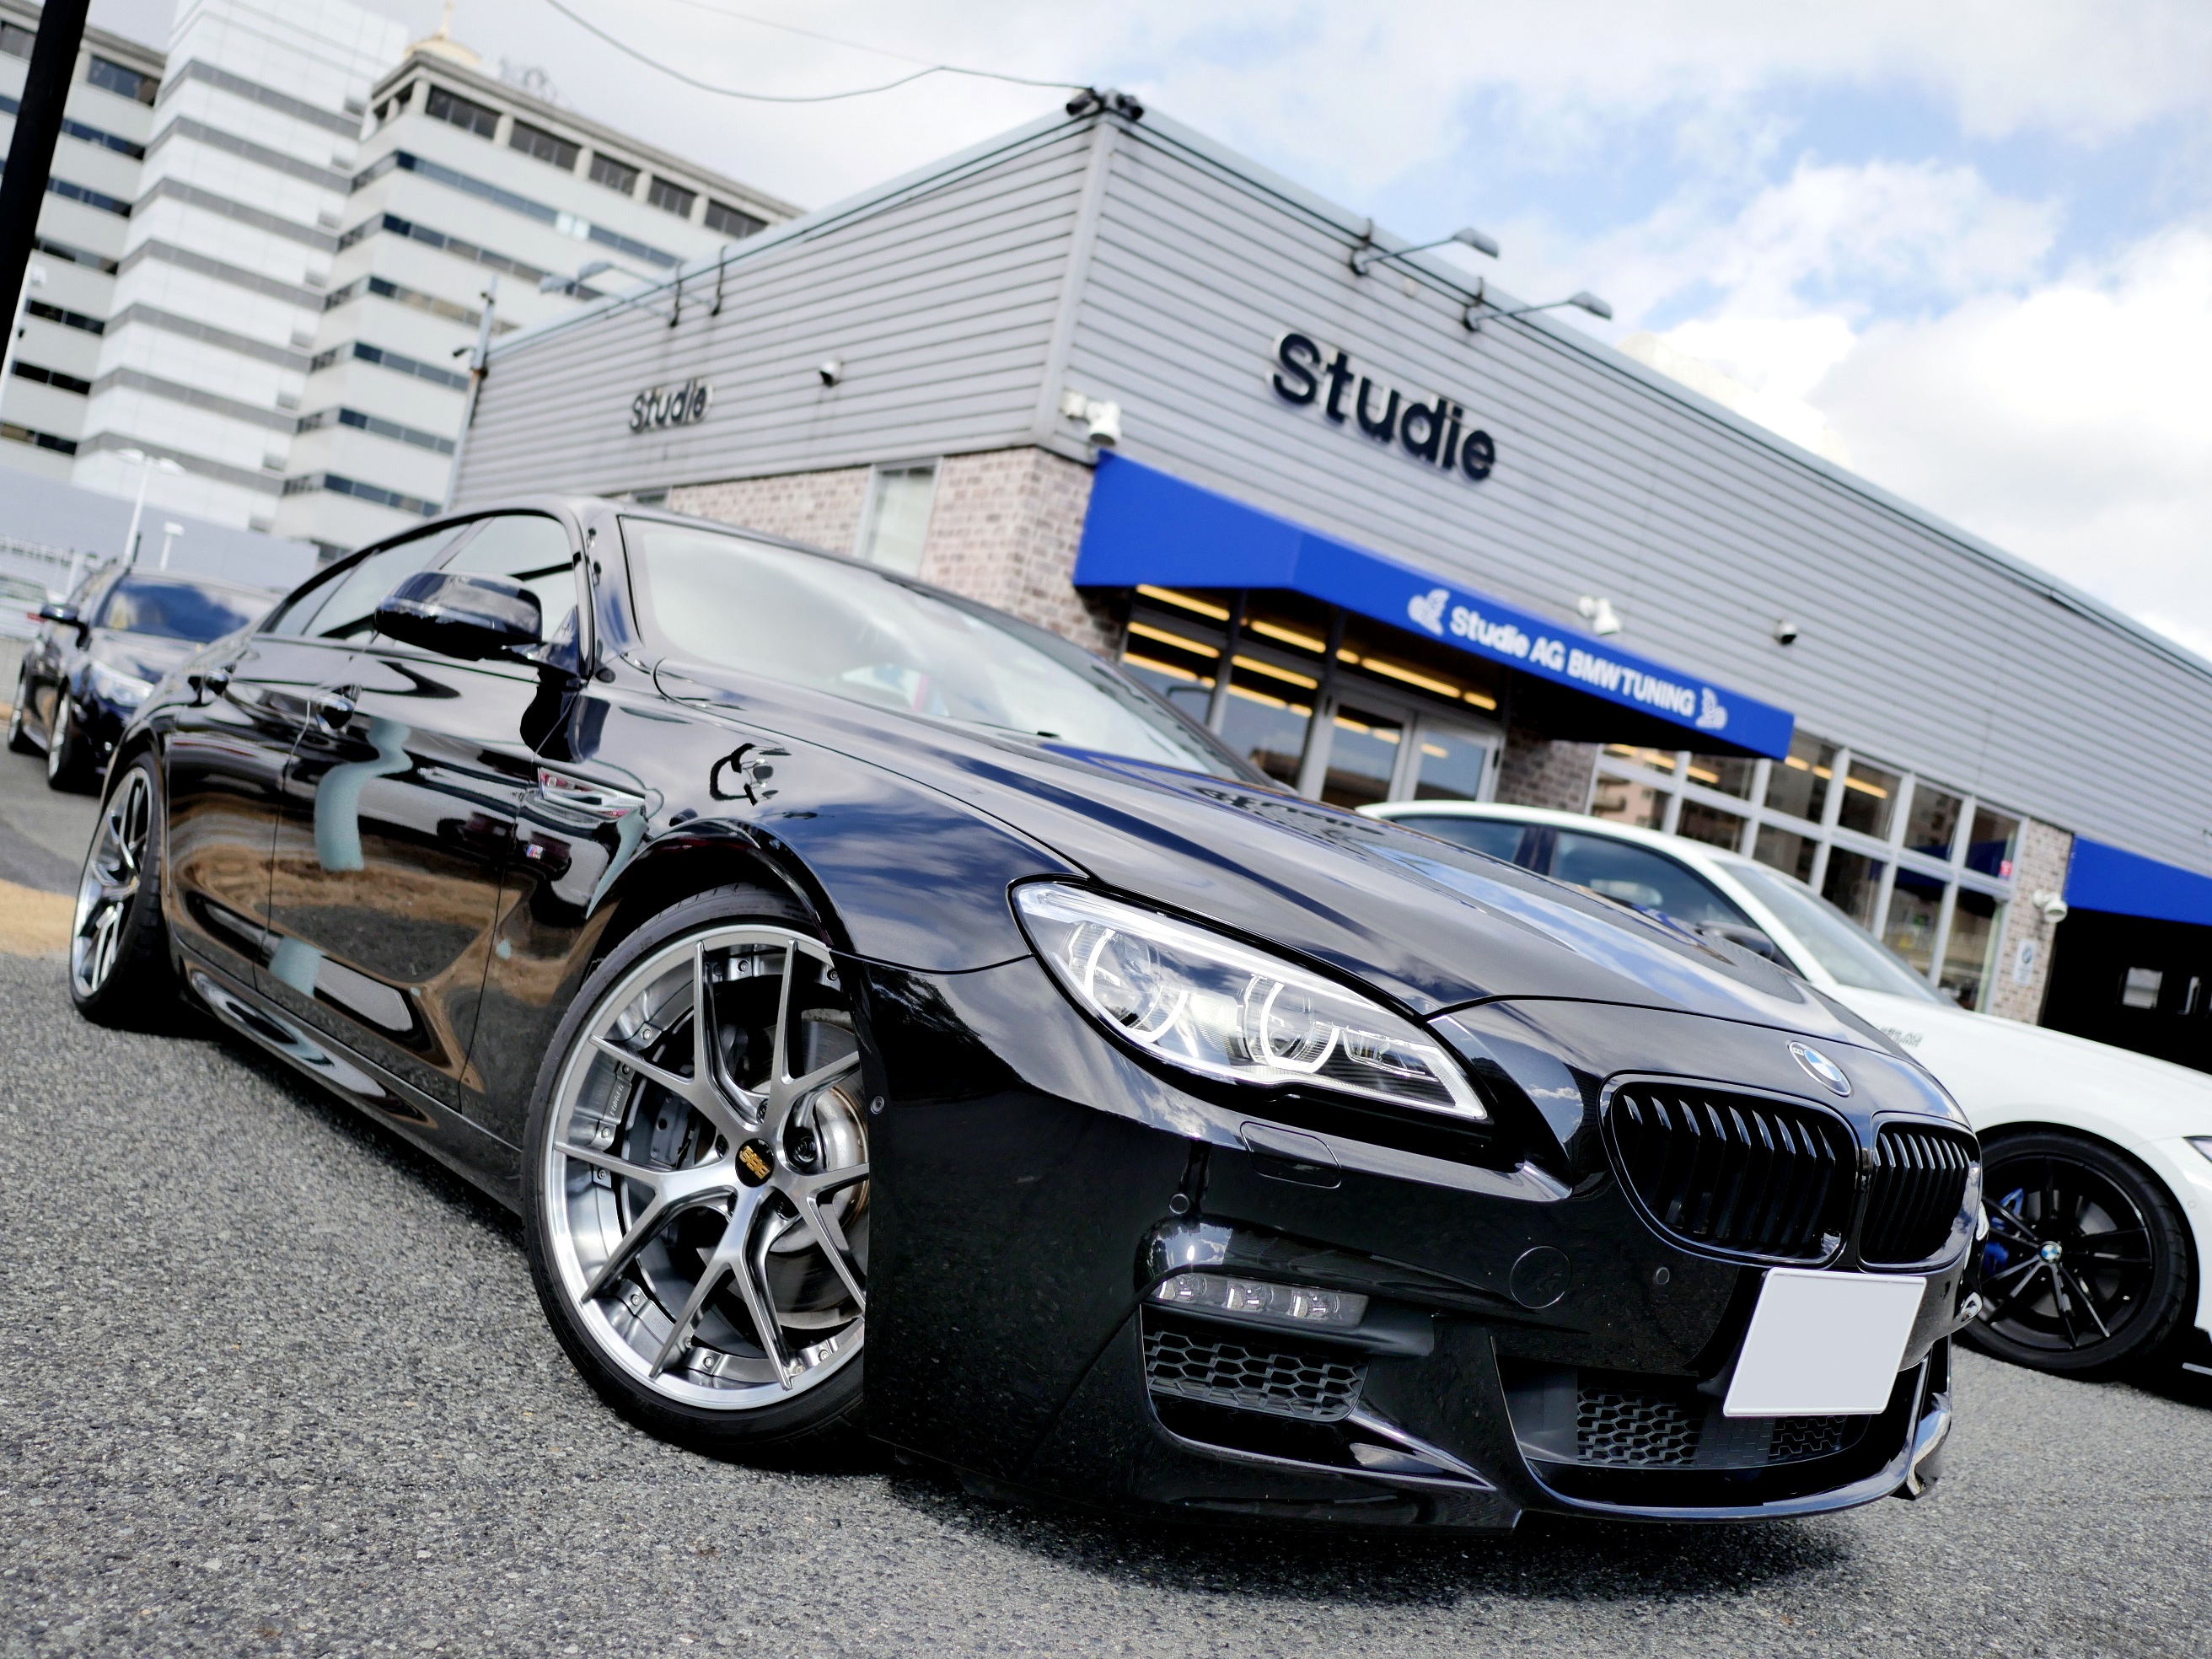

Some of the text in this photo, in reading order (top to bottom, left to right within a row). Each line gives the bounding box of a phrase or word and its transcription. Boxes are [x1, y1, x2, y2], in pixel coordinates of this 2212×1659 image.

[629, 378, 712, 434] Studie
[1271, 331, 1496, 482] Studie
[1449, 605, 1697, 717] Studie AG BMW TUNING
